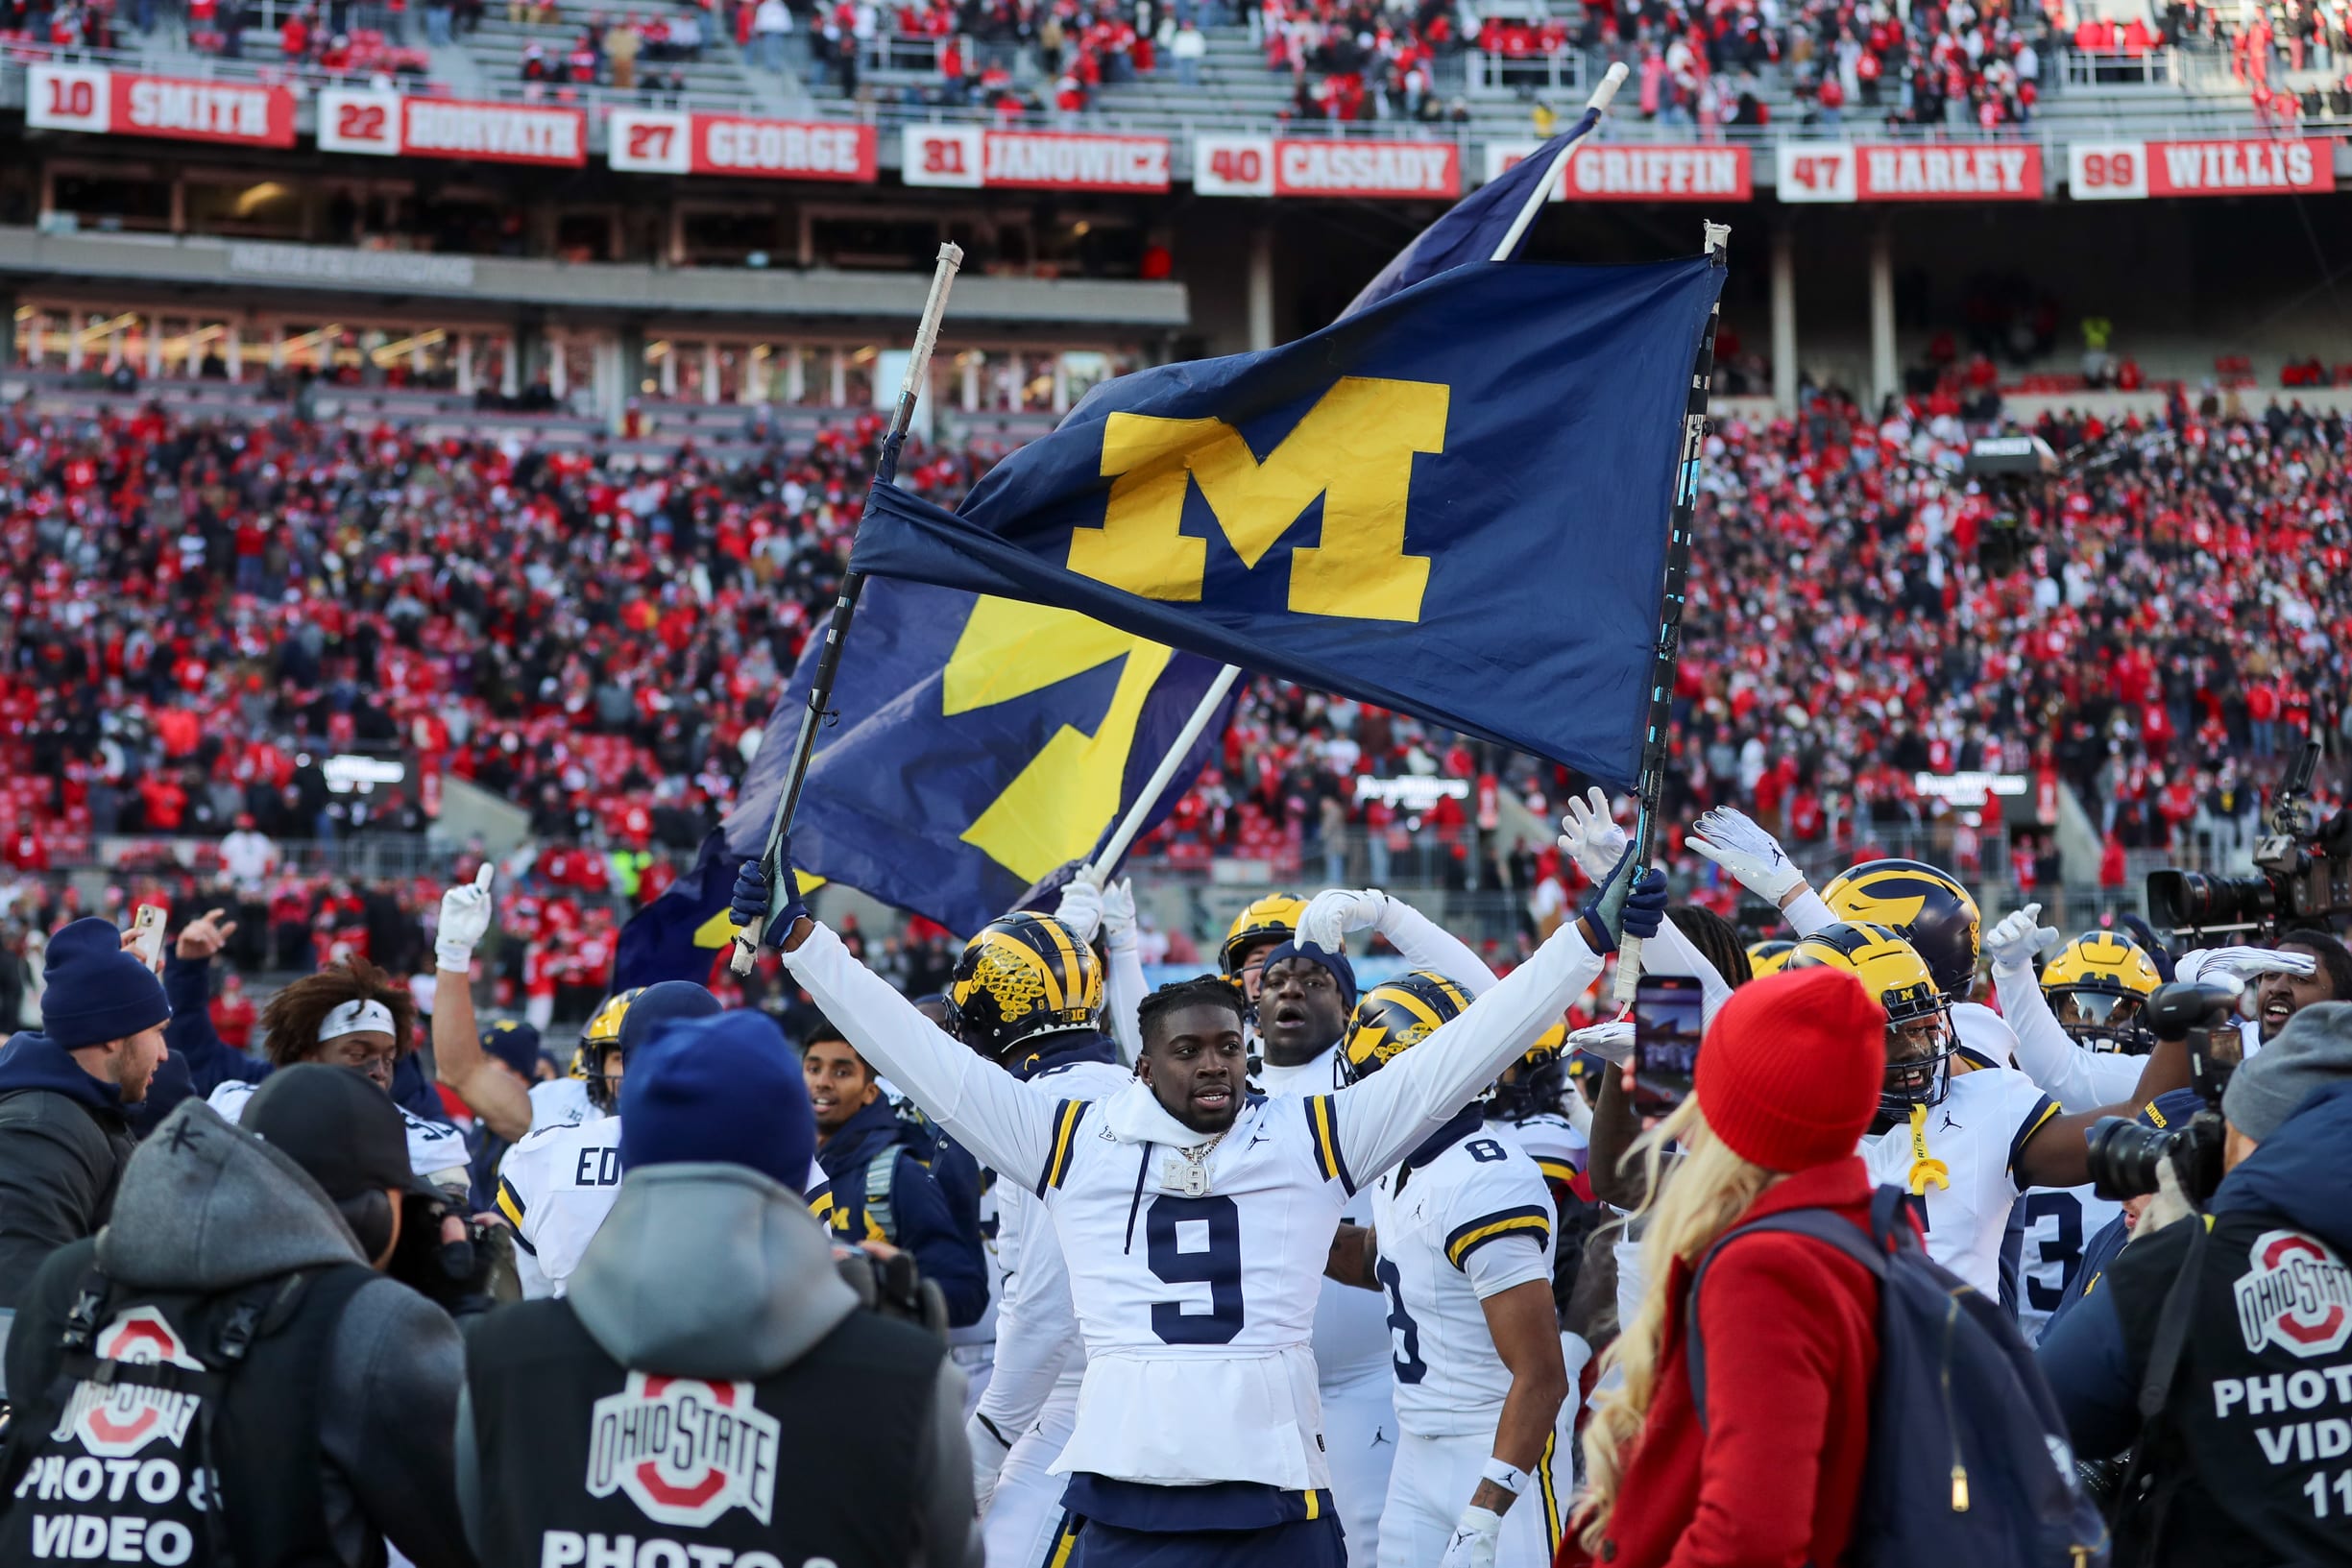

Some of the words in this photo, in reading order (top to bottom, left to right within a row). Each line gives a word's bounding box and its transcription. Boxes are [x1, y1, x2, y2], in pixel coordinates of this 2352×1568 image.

[49, 79, 94, 117] 10
[129, 81, 270, 136] SMITH
[336, 104, 386, 140] 22
[406, 101, 579, 158] HORVATH
[626, 124, 676, 159] 27
[707, 121, 860, 172] GEORGE
[985, 135, 1169, 185] JANOWICZ
[1209, 148, 1261, 184] 40
[1279, 145, 1450, 191] CASSADY
[1573, 146, 1737, 193] GRIFFIN
[1792, 155, 1843, 191] 47
[1868, 149, 2026, 191] HARLEY
[2082, 153, 2134, 187] 99
[2166, 145, 2314, 189] WILLIS
[1066, 375, 1450, 623] M
[1901, 988, 1915, 1001] M
[575, 1146, 620, 1186] ED
[1465, 1139, 1508, 1163] 8
[1147, 1194, 1244, 1344] 9
[14, 1456, 181, 1505] PHOTO
[33, 1514, 192, 1567] VIDEO
